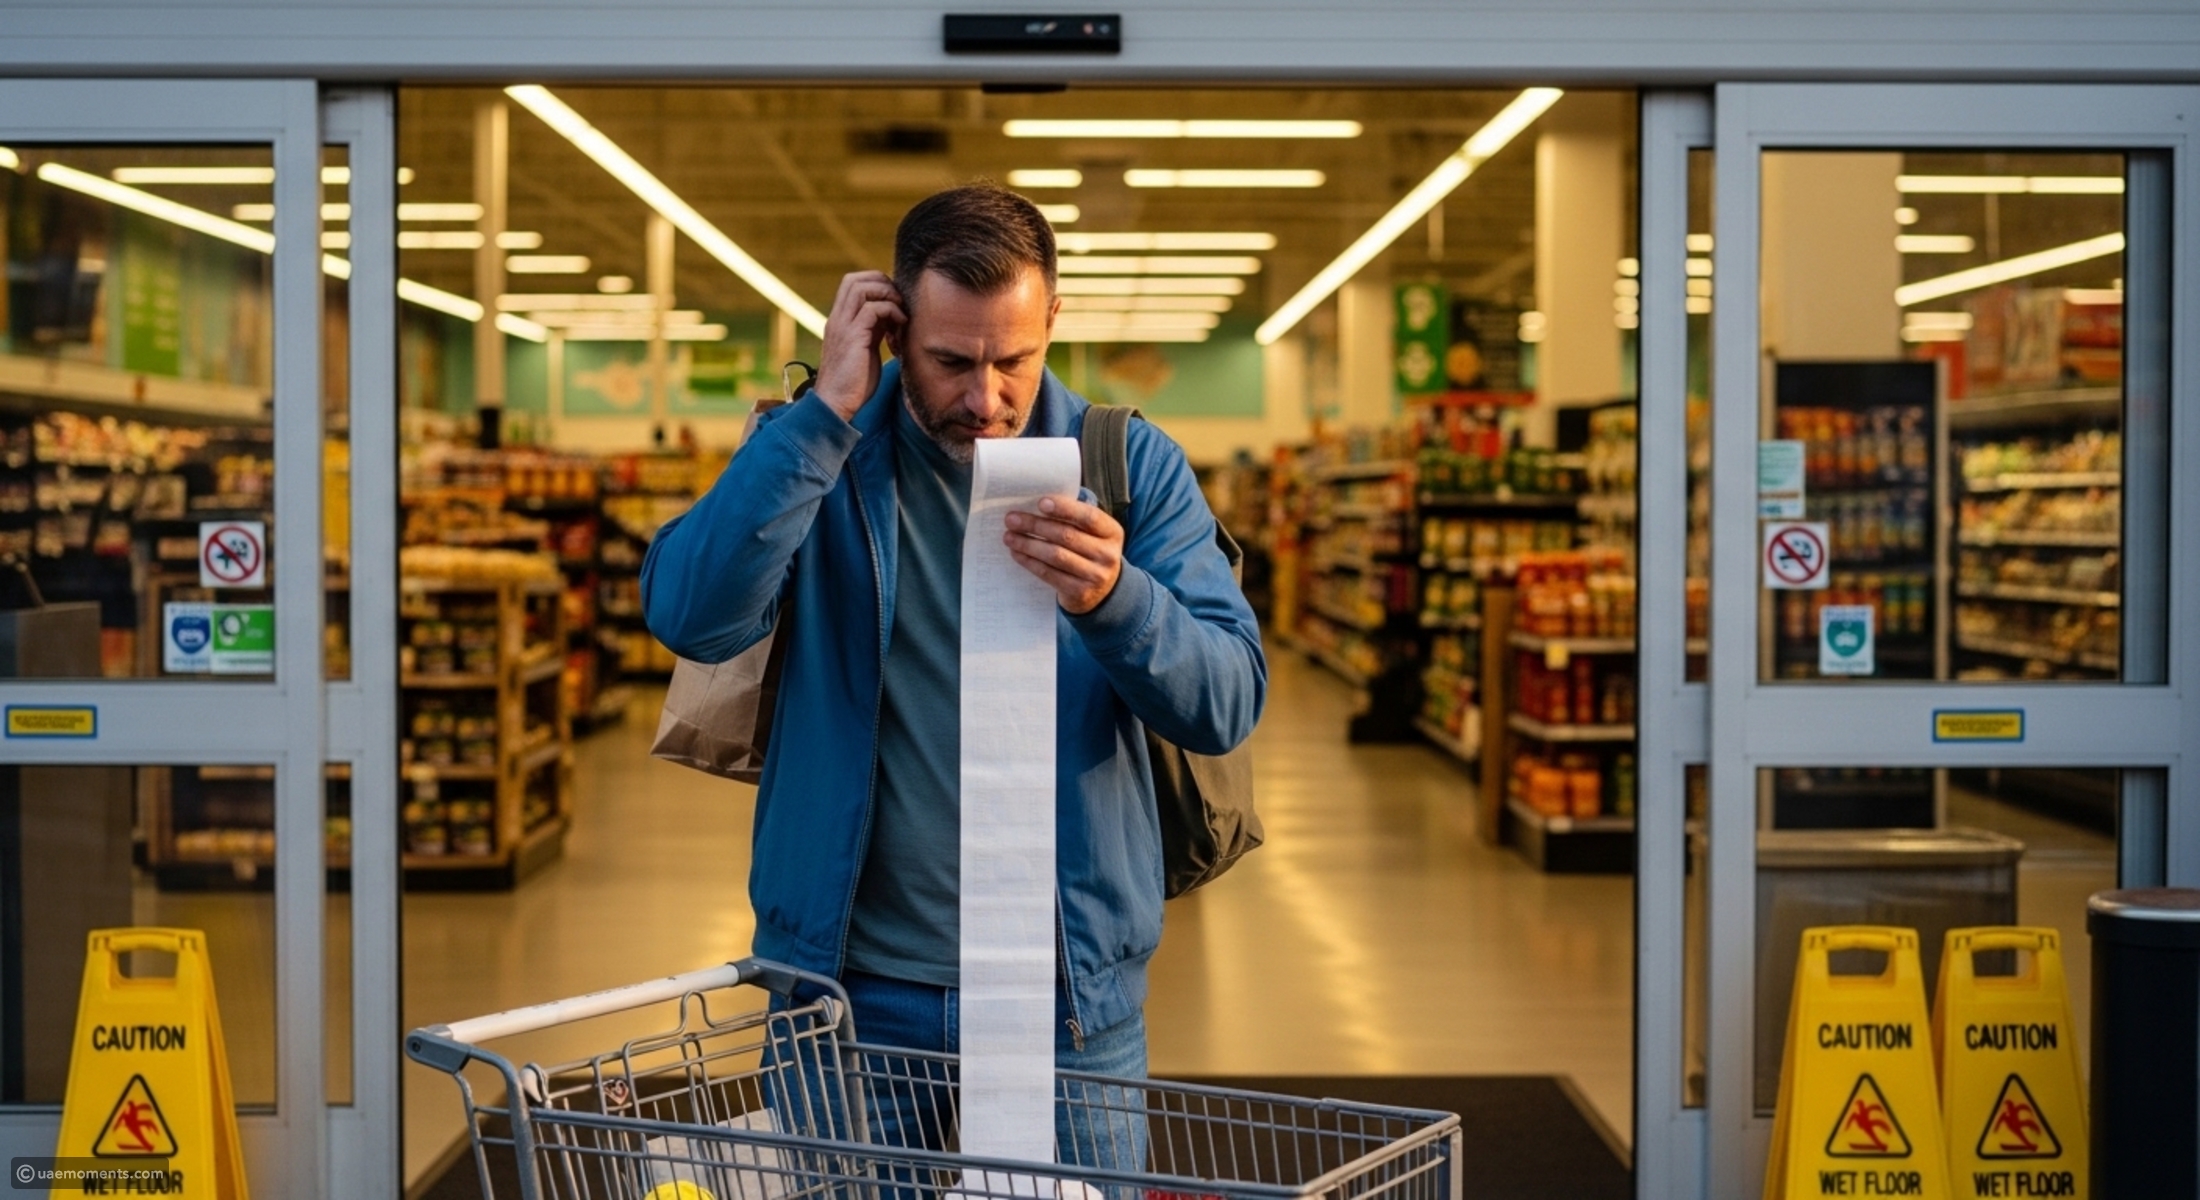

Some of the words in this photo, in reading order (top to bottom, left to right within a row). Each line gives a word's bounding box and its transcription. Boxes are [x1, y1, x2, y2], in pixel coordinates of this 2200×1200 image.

[92, 1025, 186, 1050] CAUTION
[1818, 1023, 1913, 1049] CAUTION
[1965, 1024, 2058, 1050] CAUTION
[83, 1171, 119, 1196] WET
[126, 1170, 184, 1196] FLOOR
[1819, 1171, 1857, 1195] WET
[1865, 1171, 1922, 1196] FLOOR
[1973, 1172, 2011, 1197] WET
[2016, 1172, 2075, 1197] FLOOR
